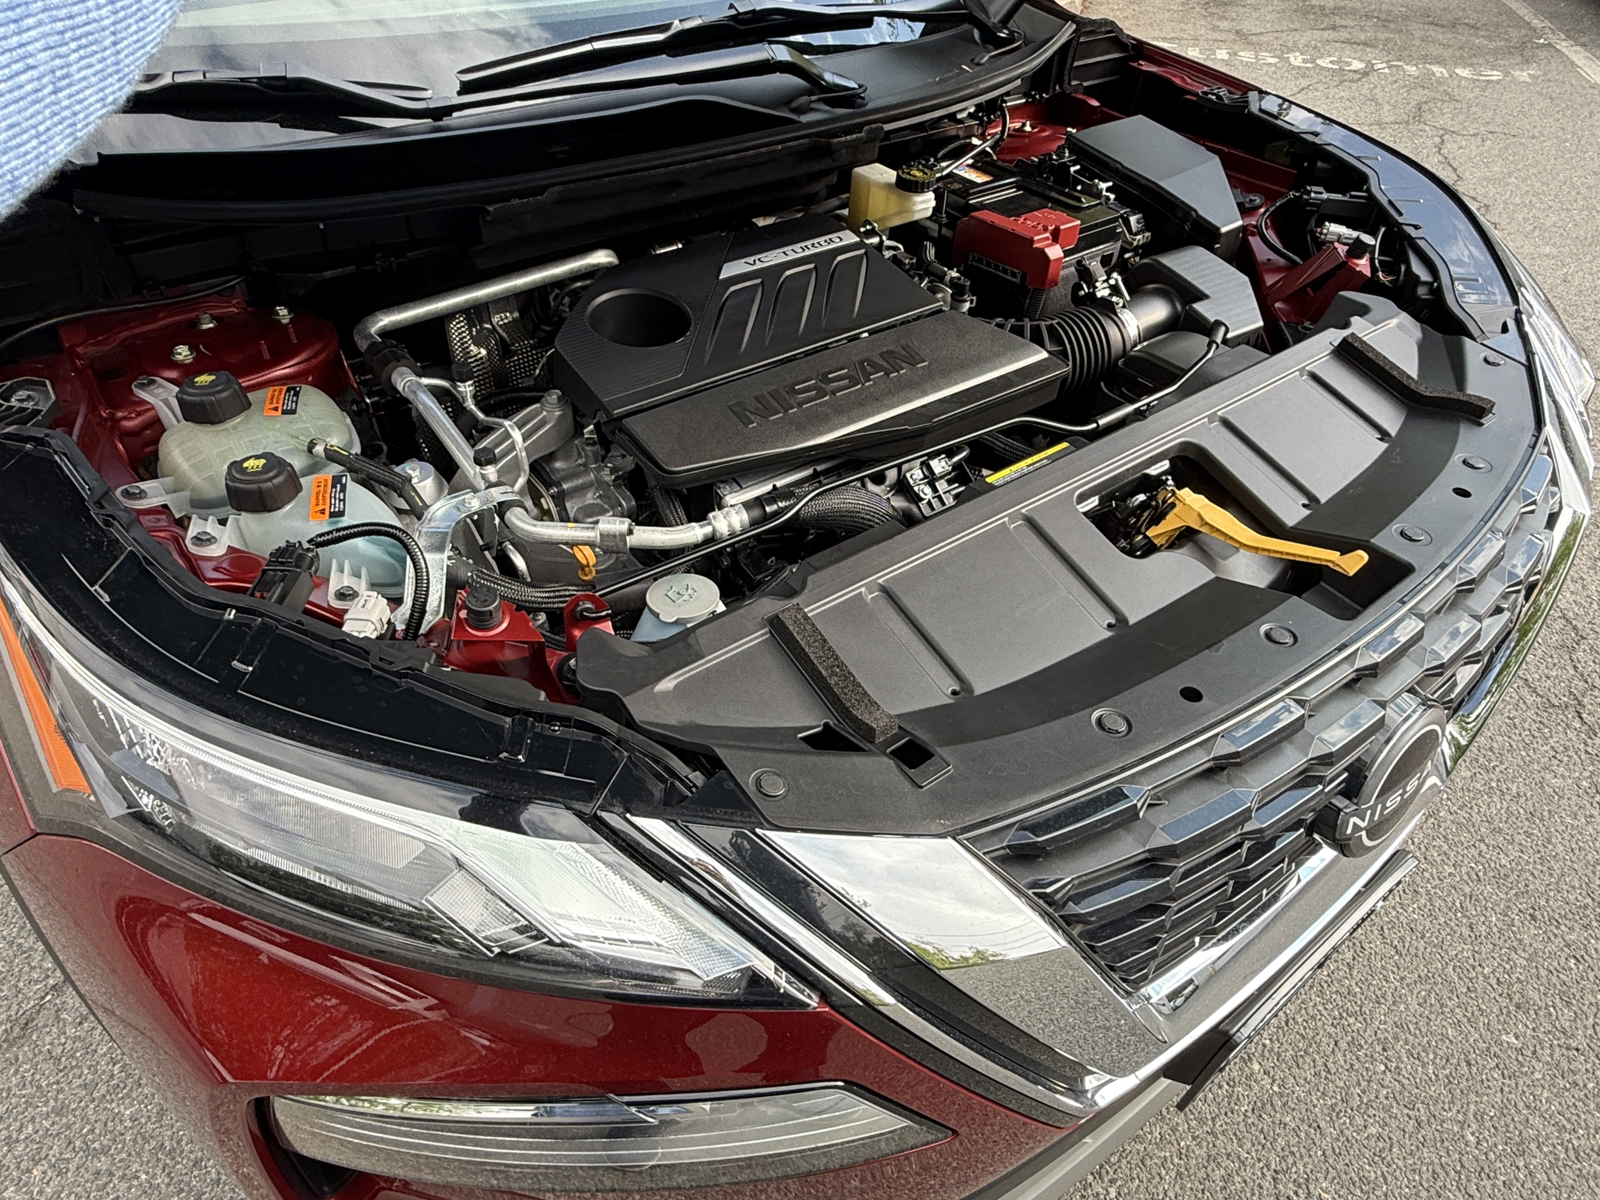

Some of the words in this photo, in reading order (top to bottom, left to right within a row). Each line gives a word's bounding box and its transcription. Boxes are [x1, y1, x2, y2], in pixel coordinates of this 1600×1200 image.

[743, 235, 844, 267] VC-TURBO
[726, 344, 929, 428] NISSAN
[1346, 760, 1432, 835] NISSA
